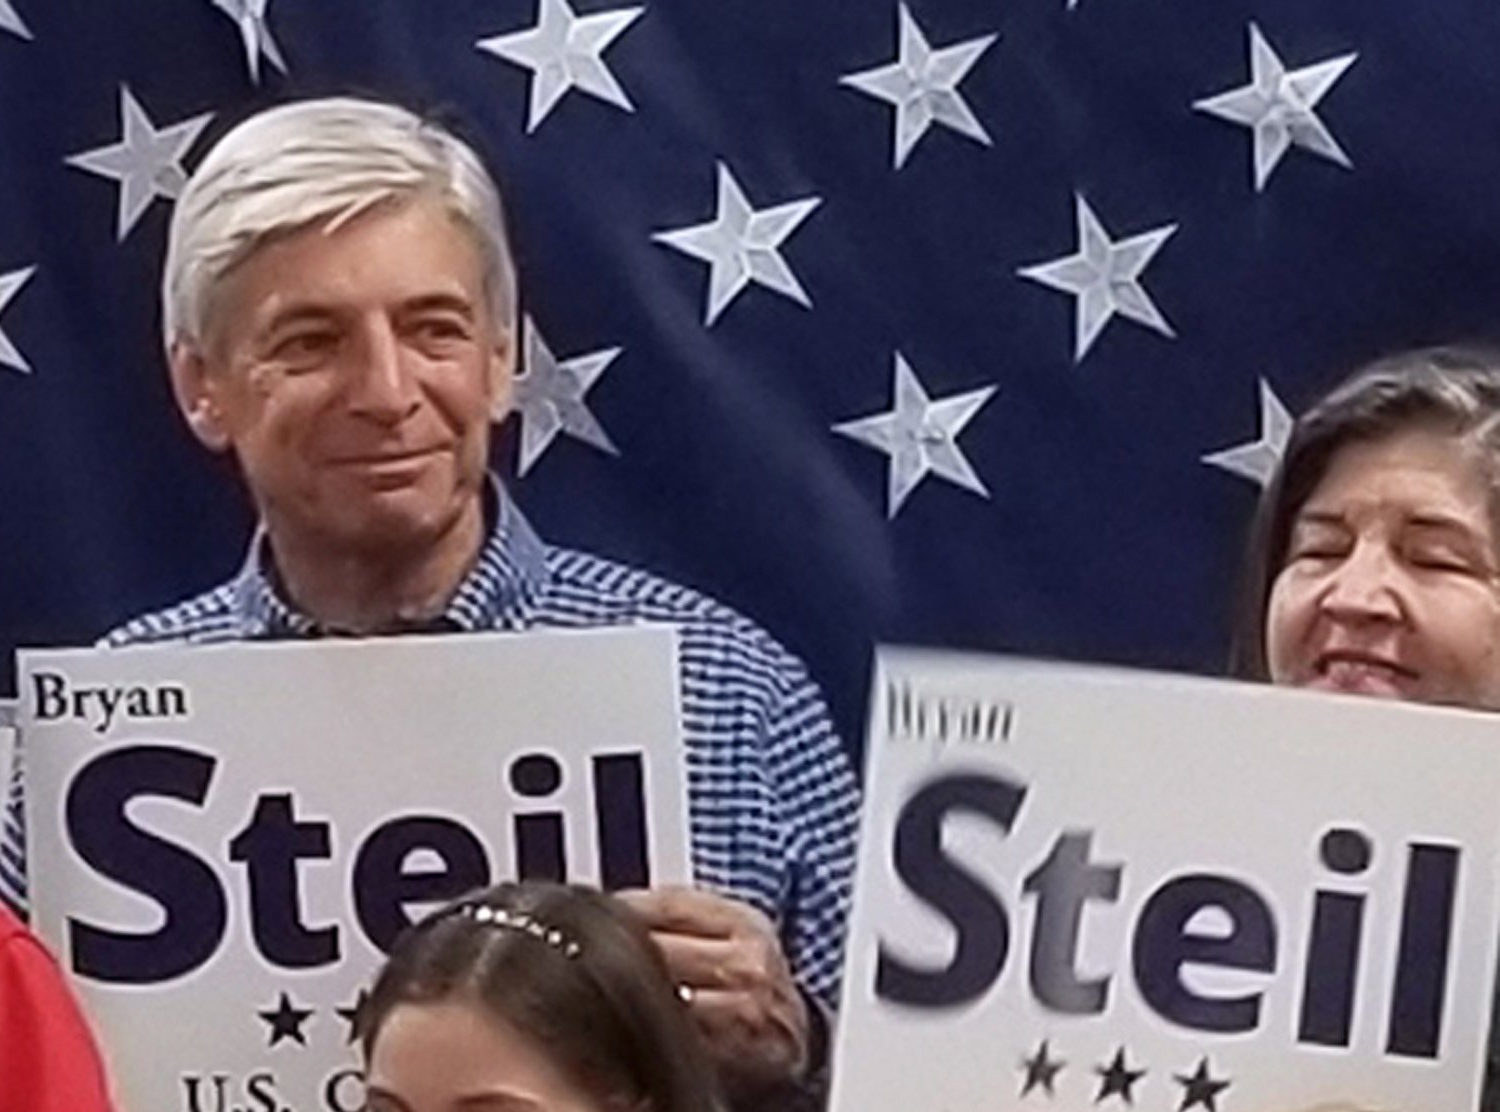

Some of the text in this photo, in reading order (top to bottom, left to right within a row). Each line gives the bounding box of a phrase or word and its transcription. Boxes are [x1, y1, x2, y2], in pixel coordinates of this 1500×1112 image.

[32, 673, 186, 733] Bryan
[64, 744, 650, 985] Steil
[873, 773, 1462, 1060] Steil
